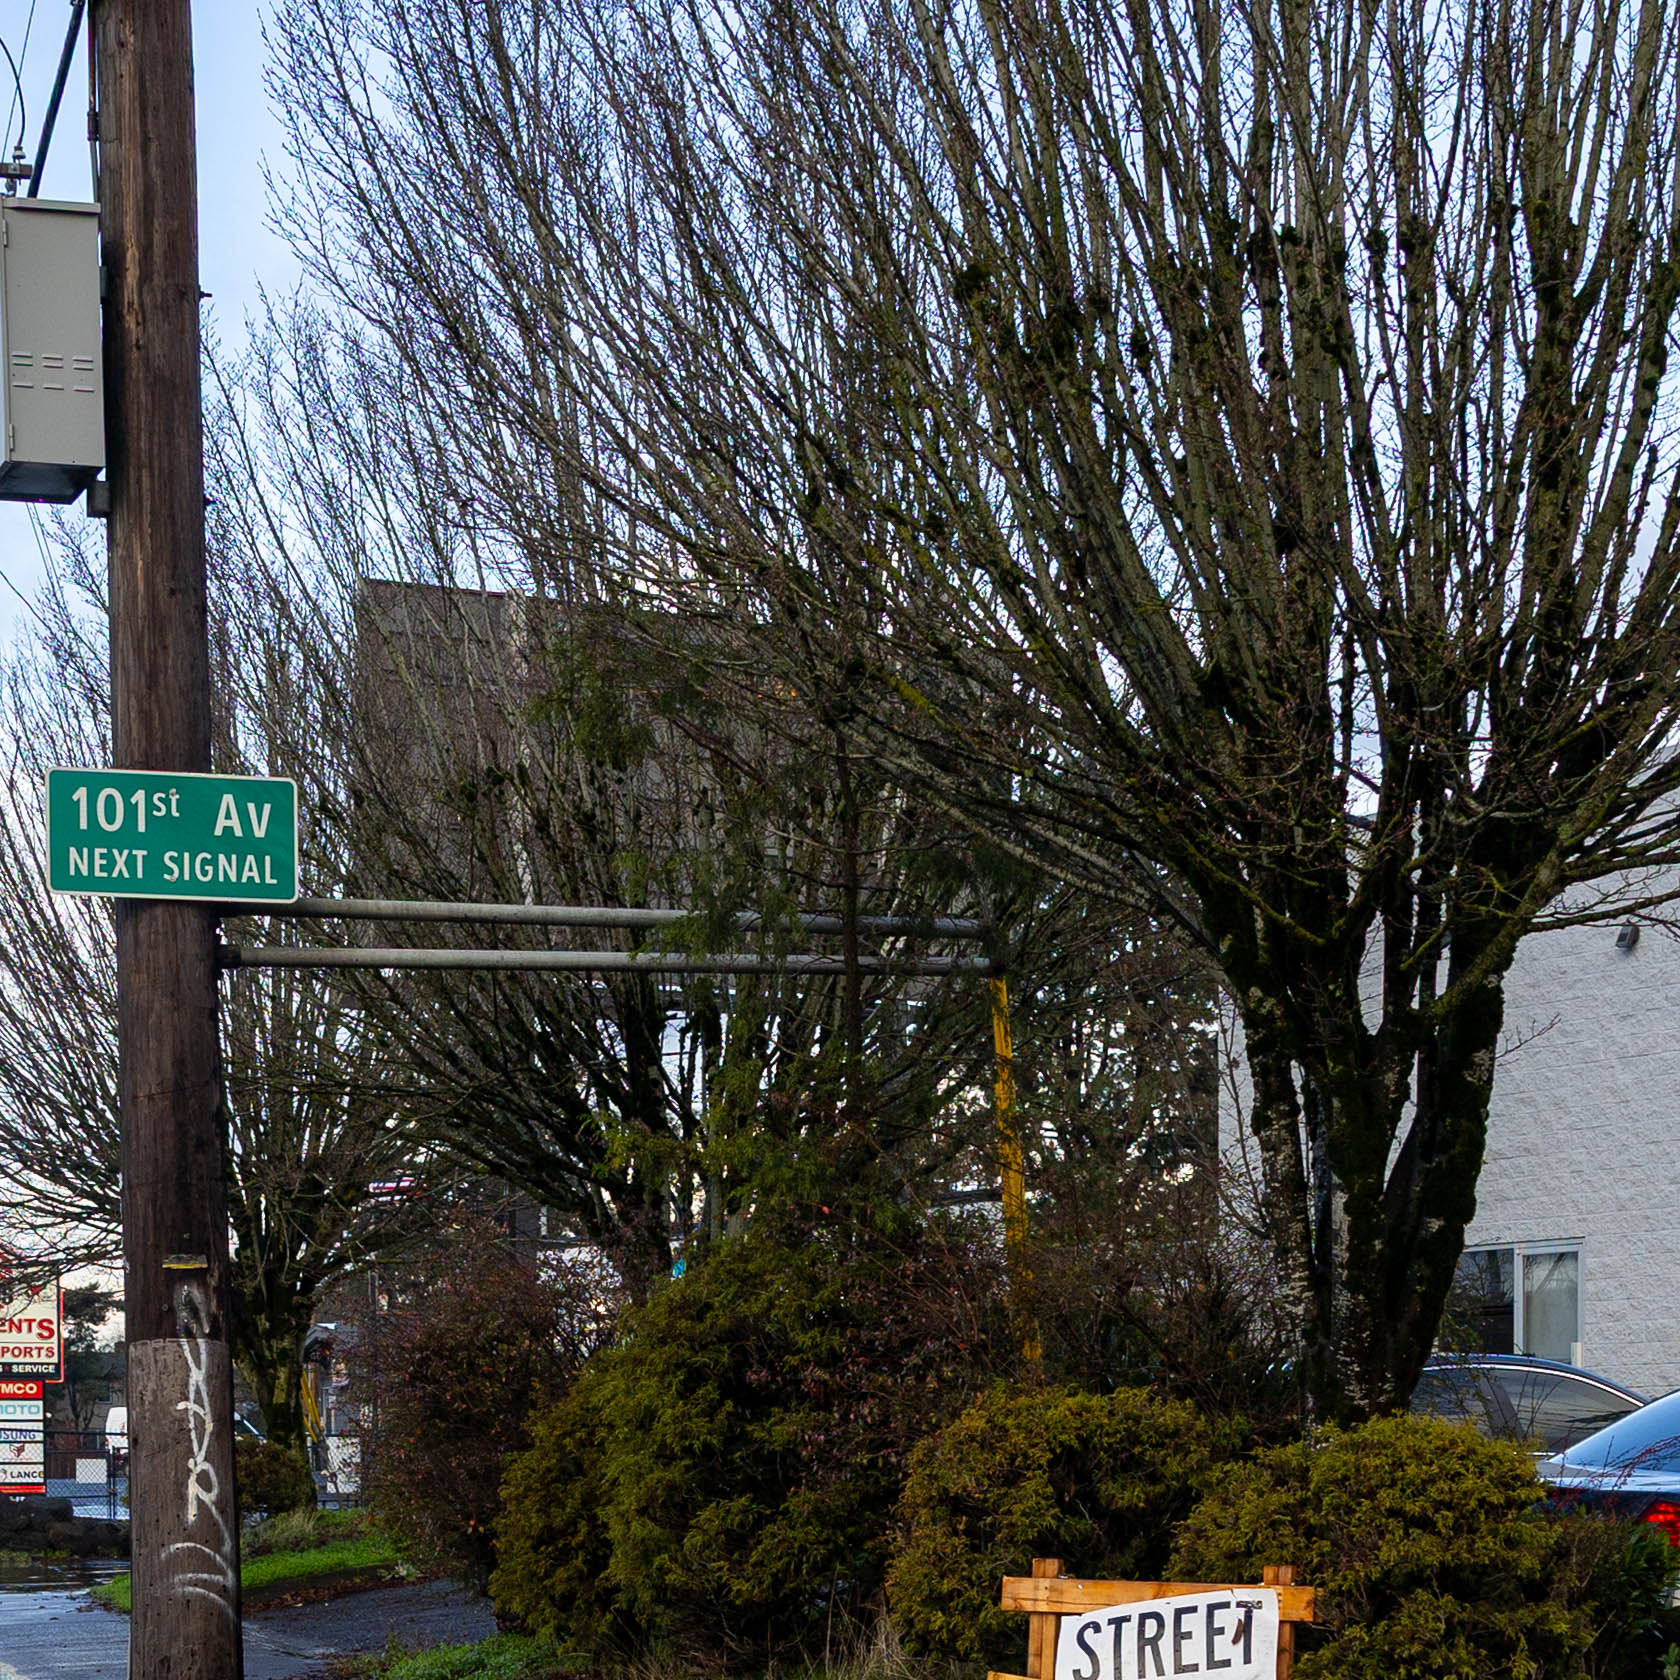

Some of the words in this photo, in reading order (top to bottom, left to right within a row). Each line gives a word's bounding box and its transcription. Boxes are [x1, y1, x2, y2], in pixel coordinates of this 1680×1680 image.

[71, 786, 181, 833] 101st
[68, 846, 149, 879] NEXT
[162, 850, 279, 885] SIGNAL
[11, 1365, 56, 1373] SERVICE
